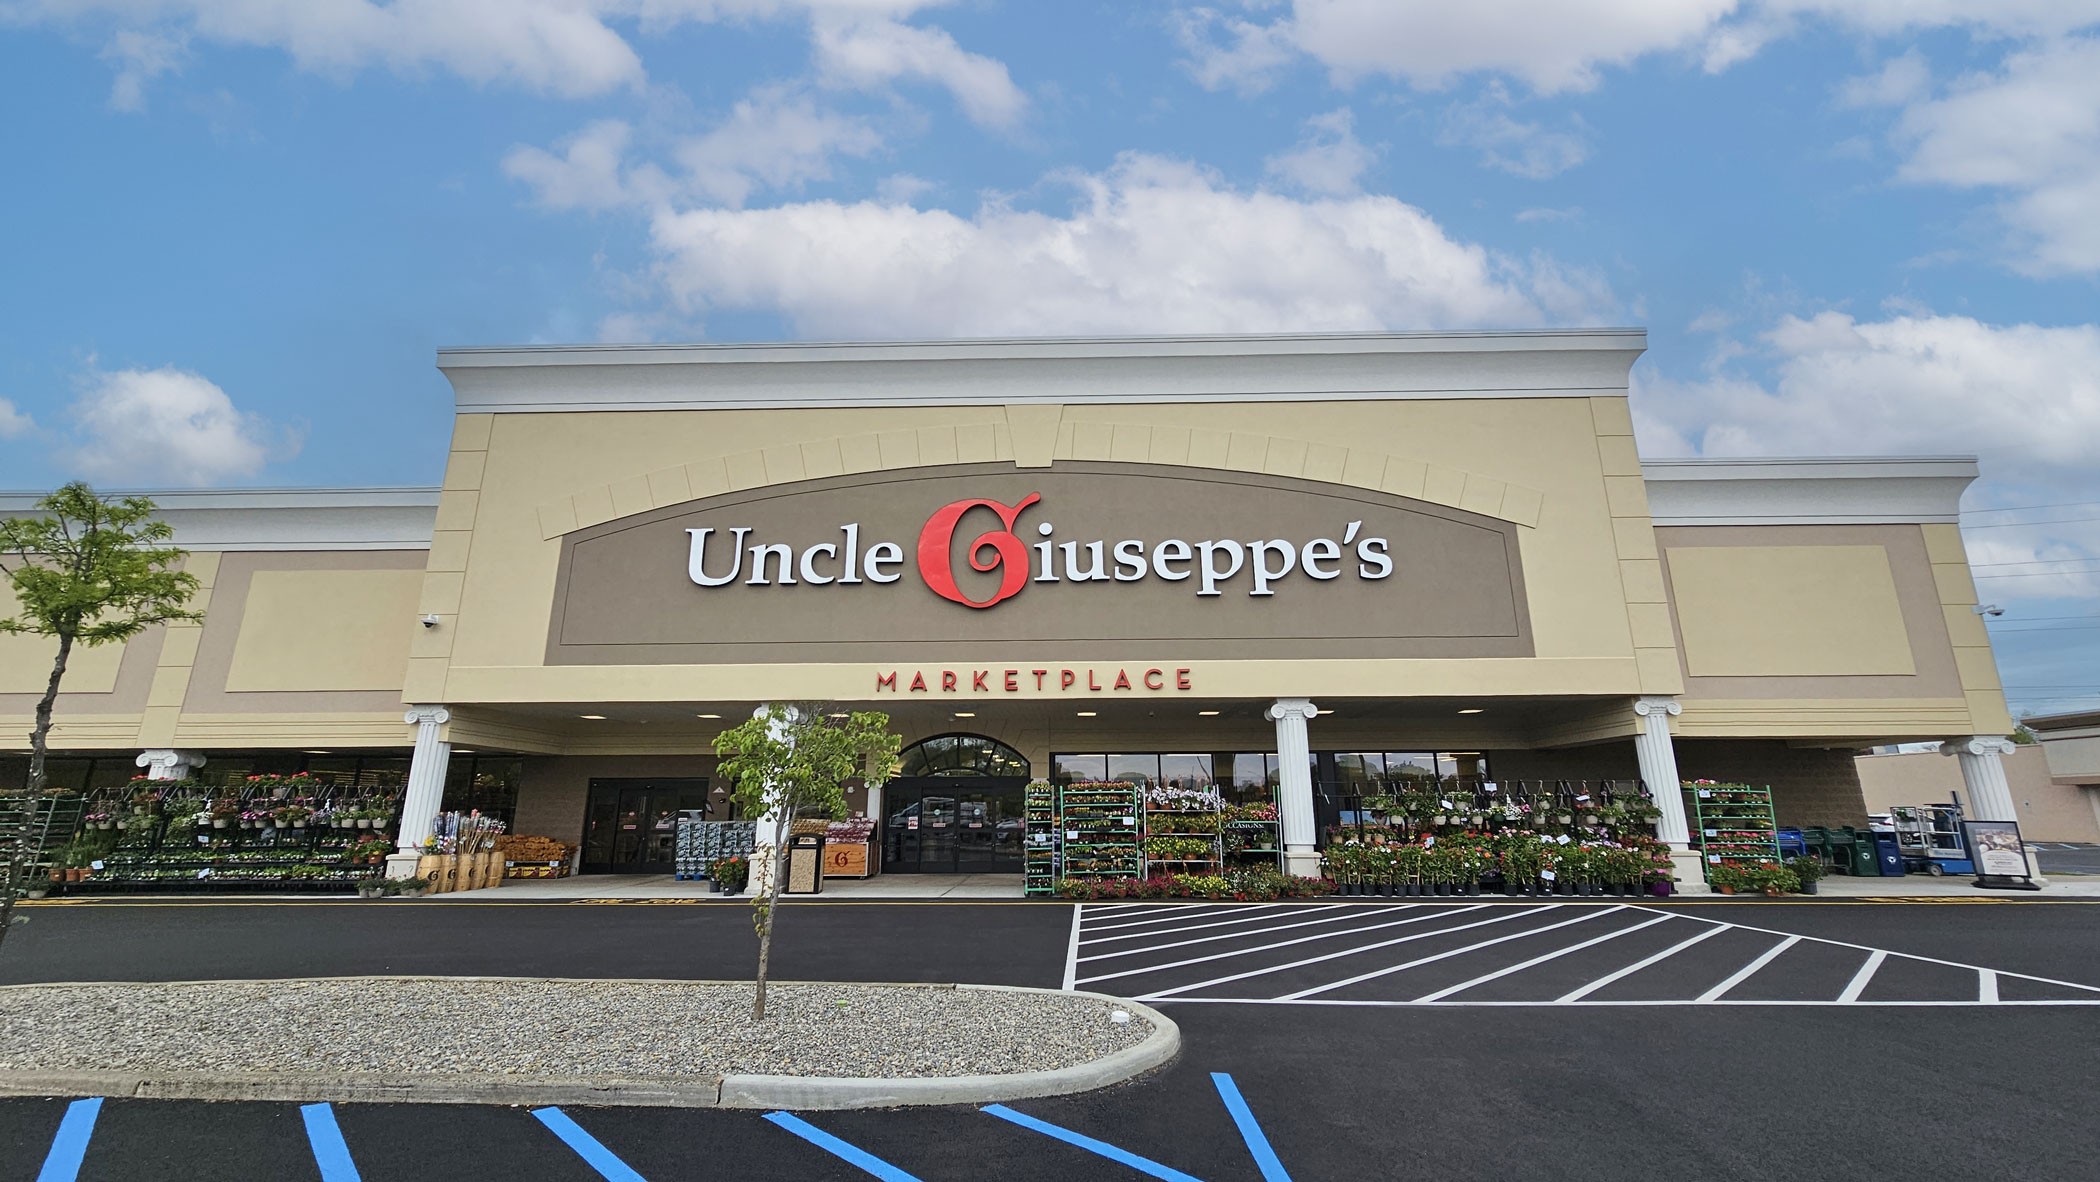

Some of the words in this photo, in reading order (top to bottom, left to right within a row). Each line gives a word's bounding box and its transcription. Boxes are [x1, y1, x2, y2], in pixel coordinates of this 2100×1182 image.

[685, 522, 905, 587] Uncle
[918, 491, 1394, 609] Giuseppe's
[876, 668, 1192, 692] MARKETPLACE
